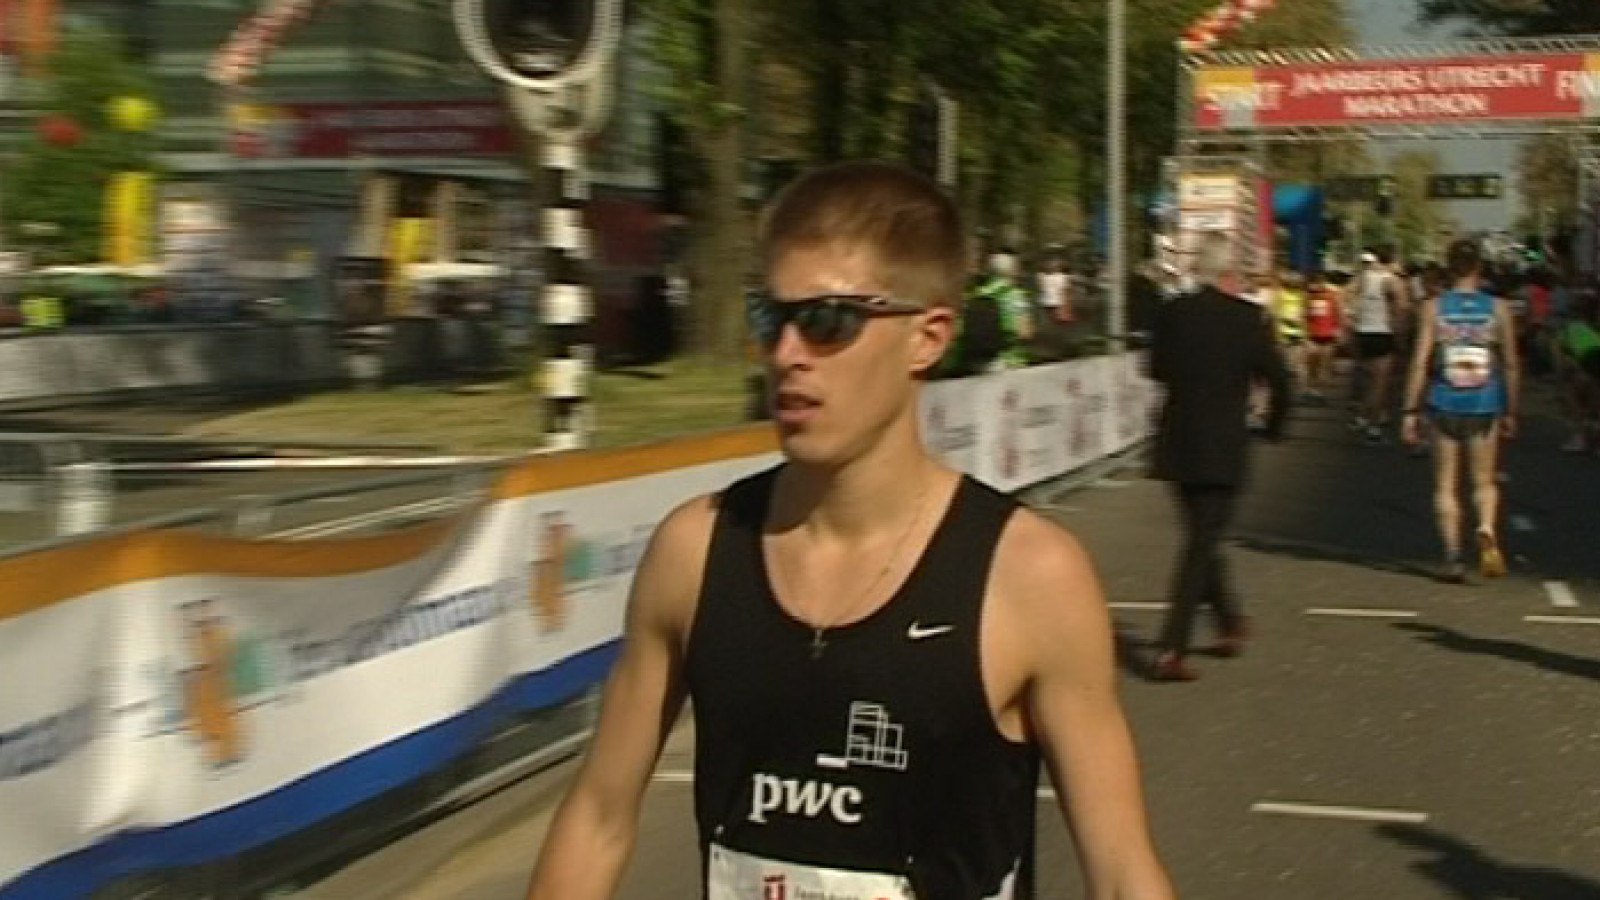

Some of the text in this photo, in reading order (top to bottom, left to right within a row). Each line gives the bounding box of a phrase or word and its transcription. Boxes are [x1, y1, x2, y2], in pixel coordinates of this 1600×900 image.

[1426, 63, 1545, 90] UTRECHT
[1342, 92, 1490, 119] MARATHON
[748, 773, 863, 823] pwc
